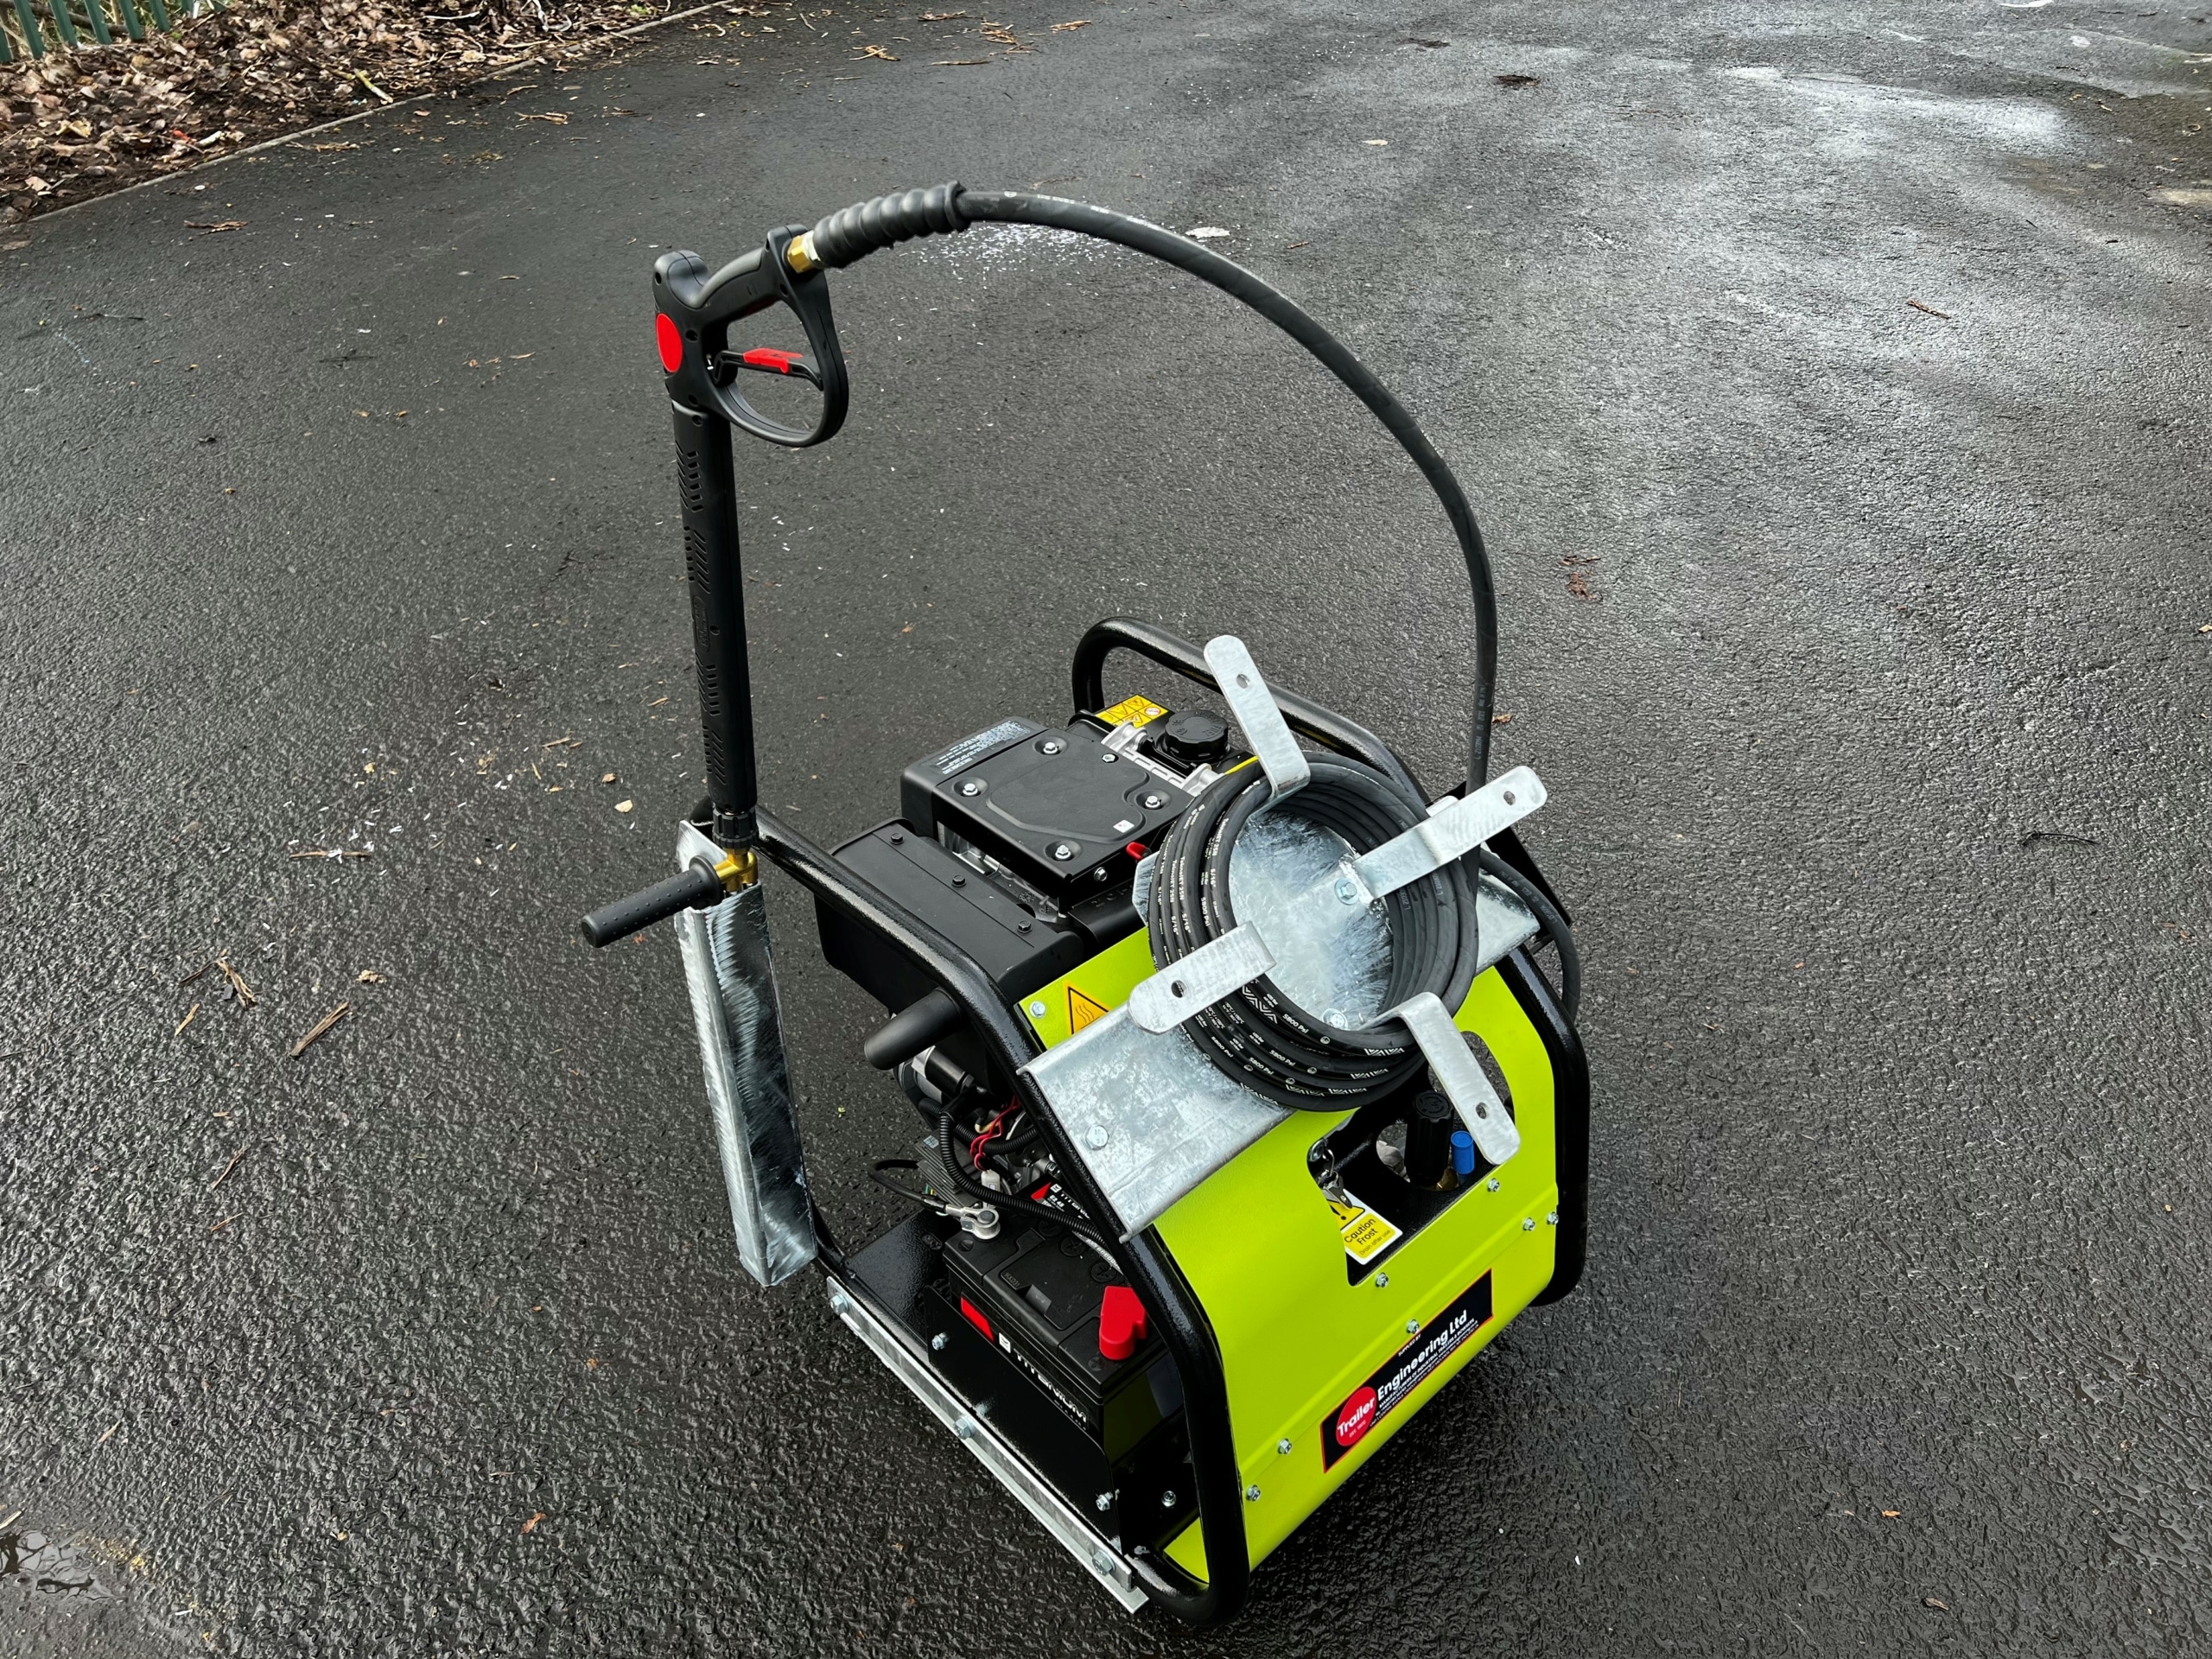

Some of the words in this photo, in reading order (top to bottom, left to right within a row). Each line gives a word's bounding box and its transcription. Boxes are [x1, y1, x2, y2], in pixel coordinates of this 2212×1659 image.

[1282, 1013, 1298, 1027] 5800
[1297, 1024, 1310, 1034] Psi
[1248, 1057, 1265, 1070] 5800
[1268, 1049, 1286, 1062] 5800
[1344, 1218, 1376, 1243] Caution
[1356, 1228, 1379, 1245] Frost
[1359, 1244, 1373, 1255] Drain
[1371, 1236, 1382, 1246] after
[1337, 1397, 1376, 1437] Trailer
[1377, 1330, 1448, 1402] Engineering
[1449, 1309, 1467, 1335] Ltd
